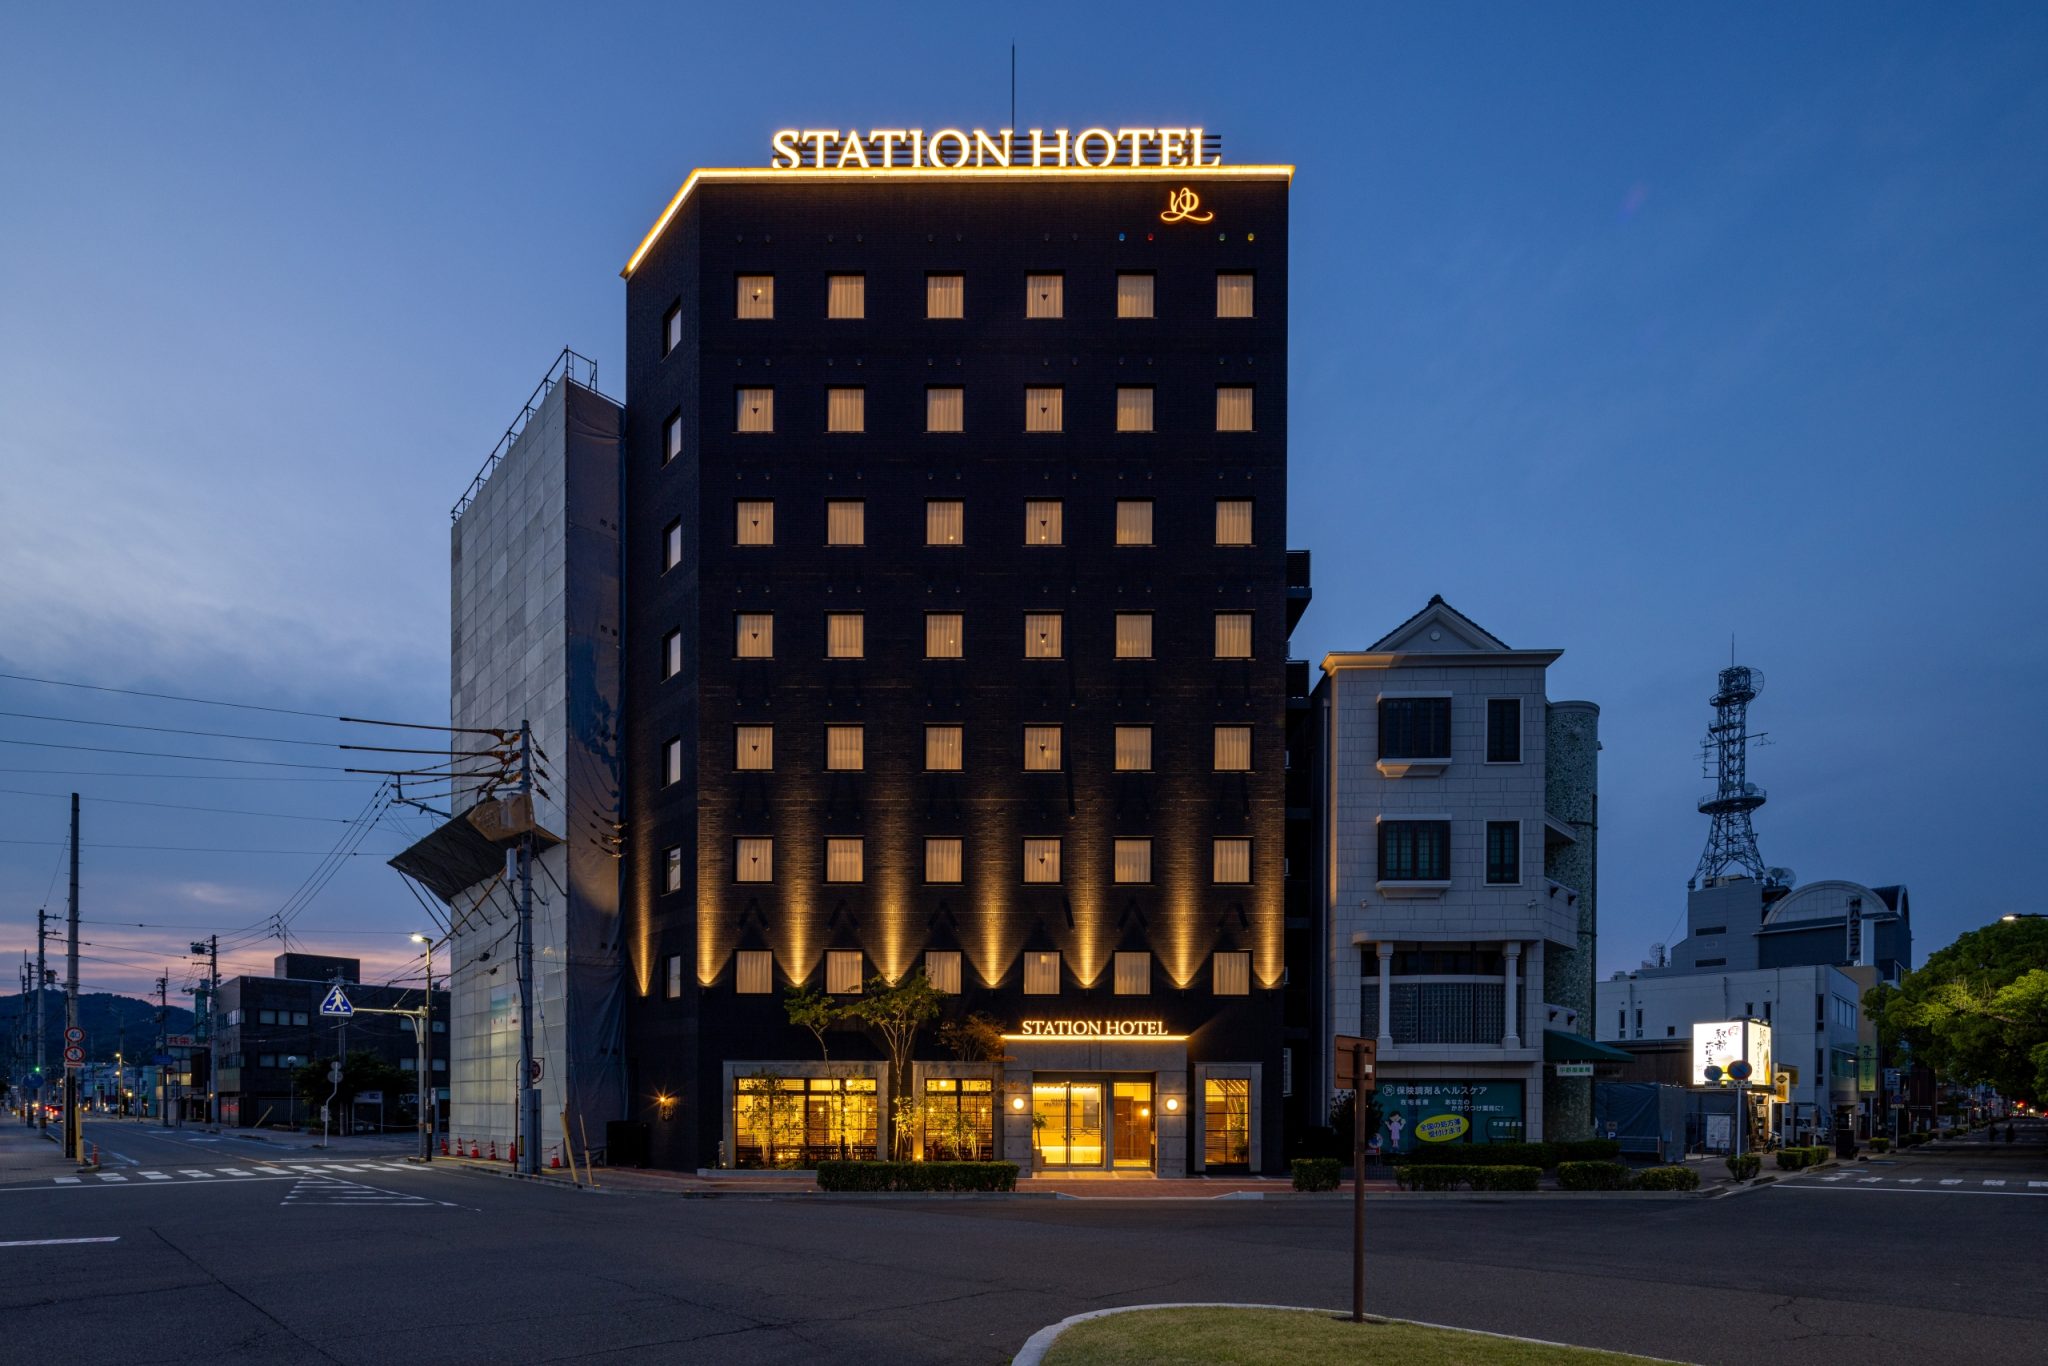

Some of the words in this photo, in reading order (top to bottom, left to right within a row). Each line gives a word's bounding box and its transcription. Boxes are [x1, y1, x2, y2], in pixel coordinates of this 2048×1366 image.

[772, 129, 1015, 168] STATION
[1029, 128, 1221, 167] HOTEL
[1022, 1020, 1102, 1035] STATION
[1106, 1021, 1168, 1035] HOTEL
